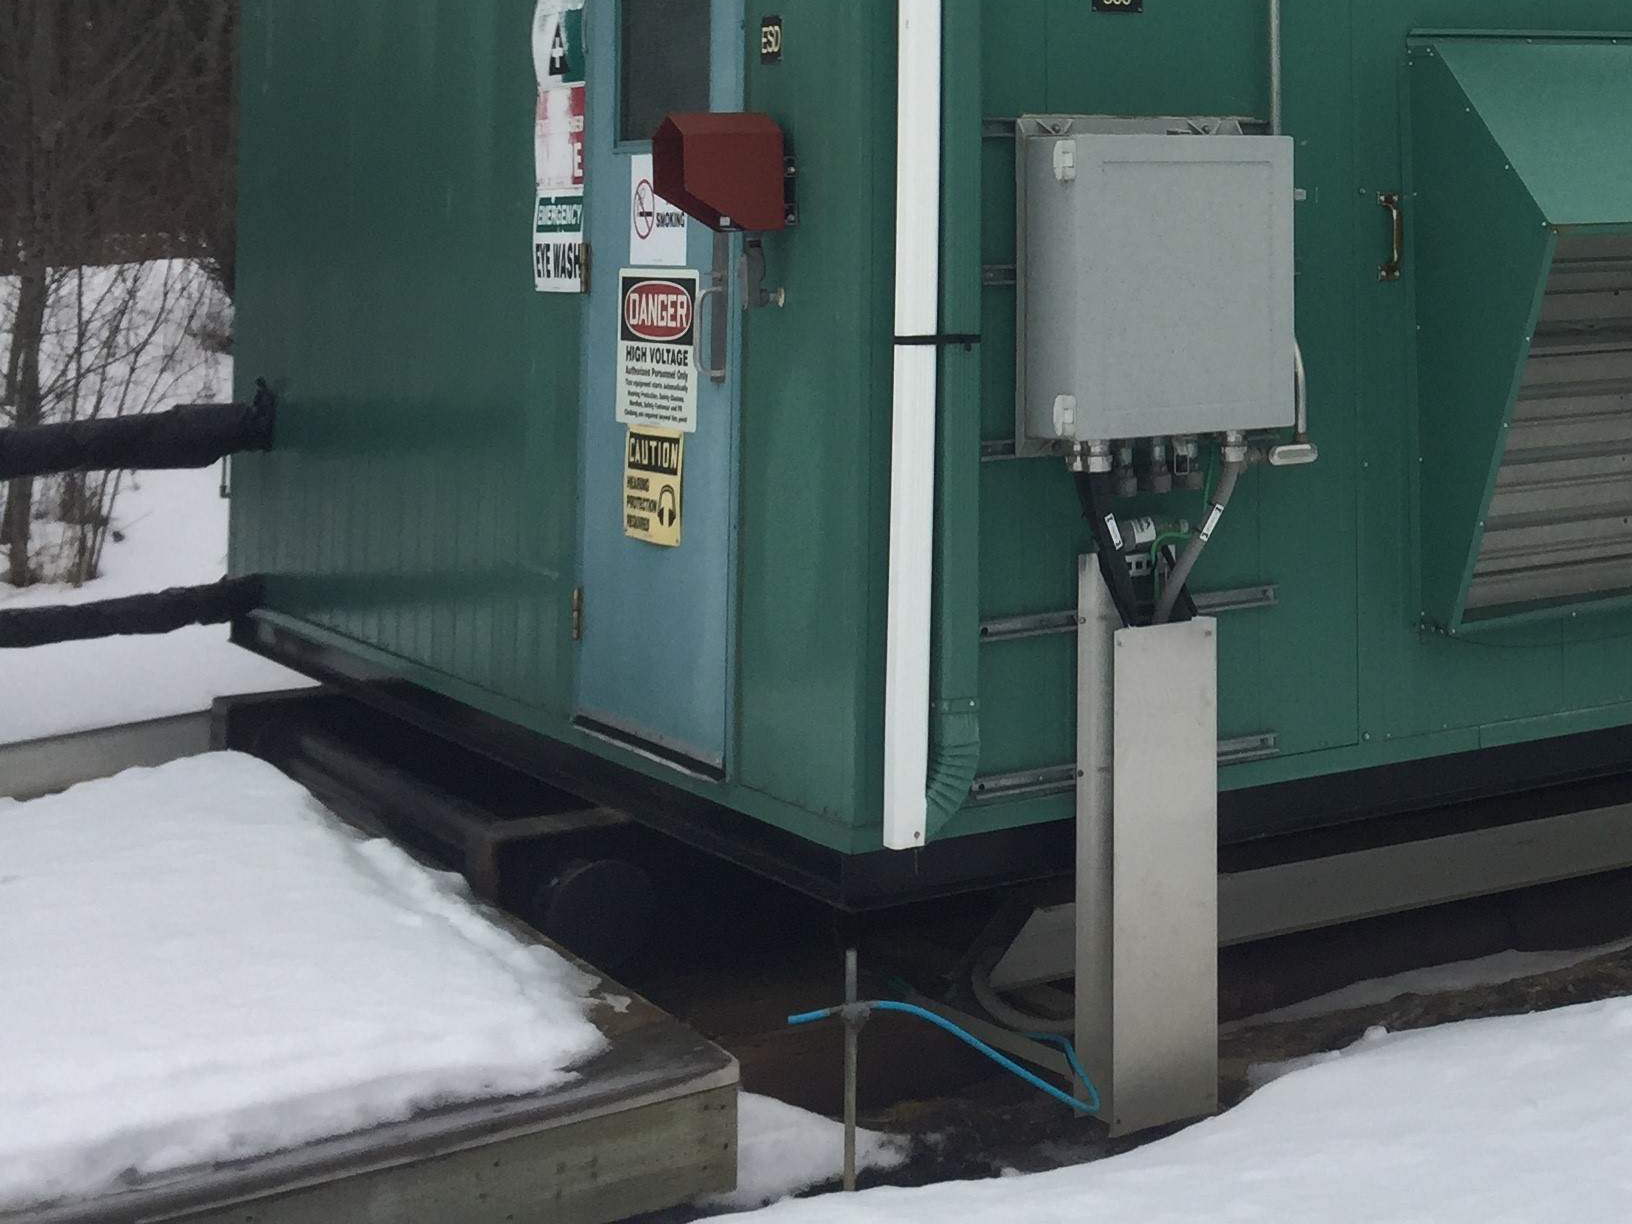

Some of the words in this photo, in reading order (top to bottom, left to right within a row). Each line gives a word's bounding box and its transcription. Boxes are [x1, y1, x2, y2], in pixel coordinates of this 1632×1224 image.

[761, 25, 781, 53] ESD
[537, 204, 582, 225] EMERGENCY
[656, 212, 685, 228] SMOKING
[535, 243, 551, 278] EYE
[553, 243, 580, 279] WASH
[629, 293, 687, 327] DANGER
[625, 345, 647, 362] HIGH
[650, 347, 688, 366] VOLTAGE
[629, 437, 678, 469] CAUTION
